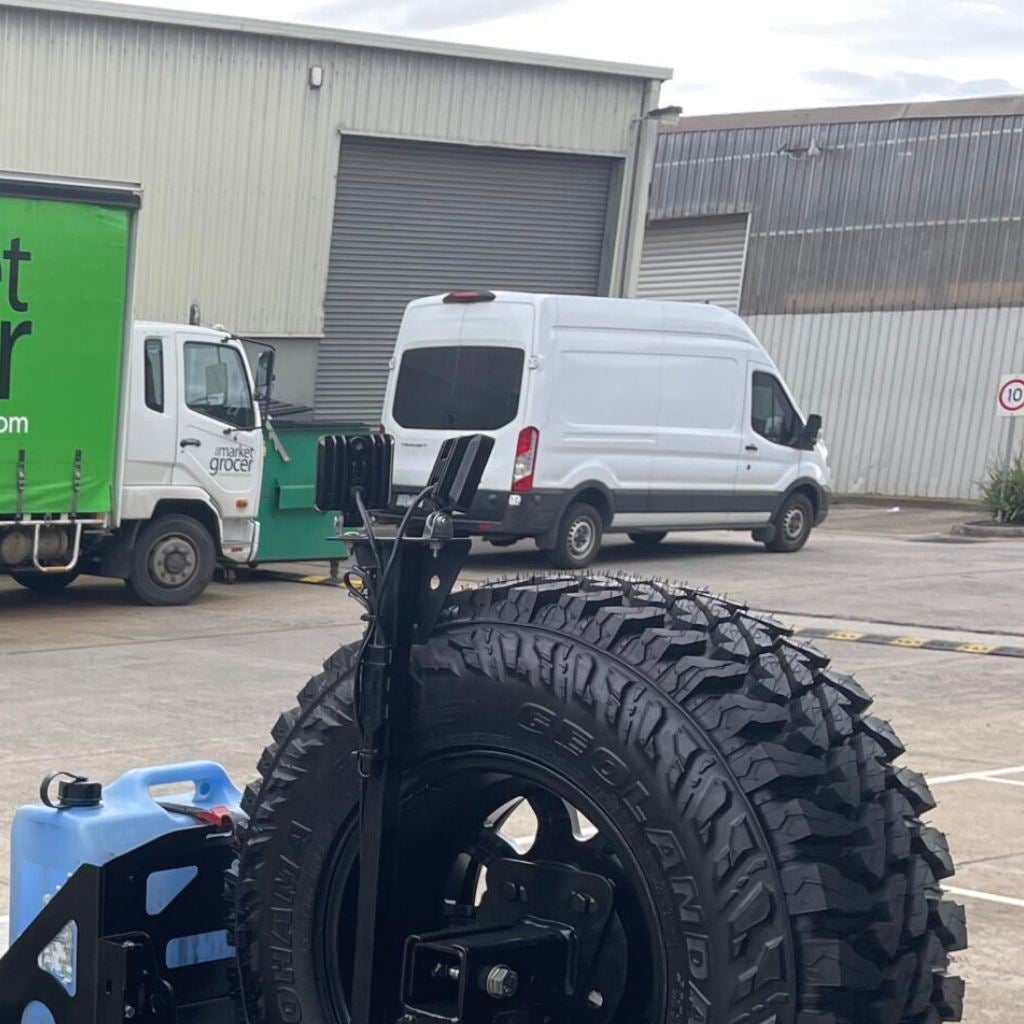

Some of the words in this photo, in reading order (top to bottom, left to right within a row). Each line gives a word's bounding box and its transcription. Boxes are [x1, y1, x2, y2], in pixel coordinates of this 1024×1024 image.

[1008, 388, 1023, 402] 10
[219, 443, 254, 458] market
[209, 457, 254, 476] grocer
